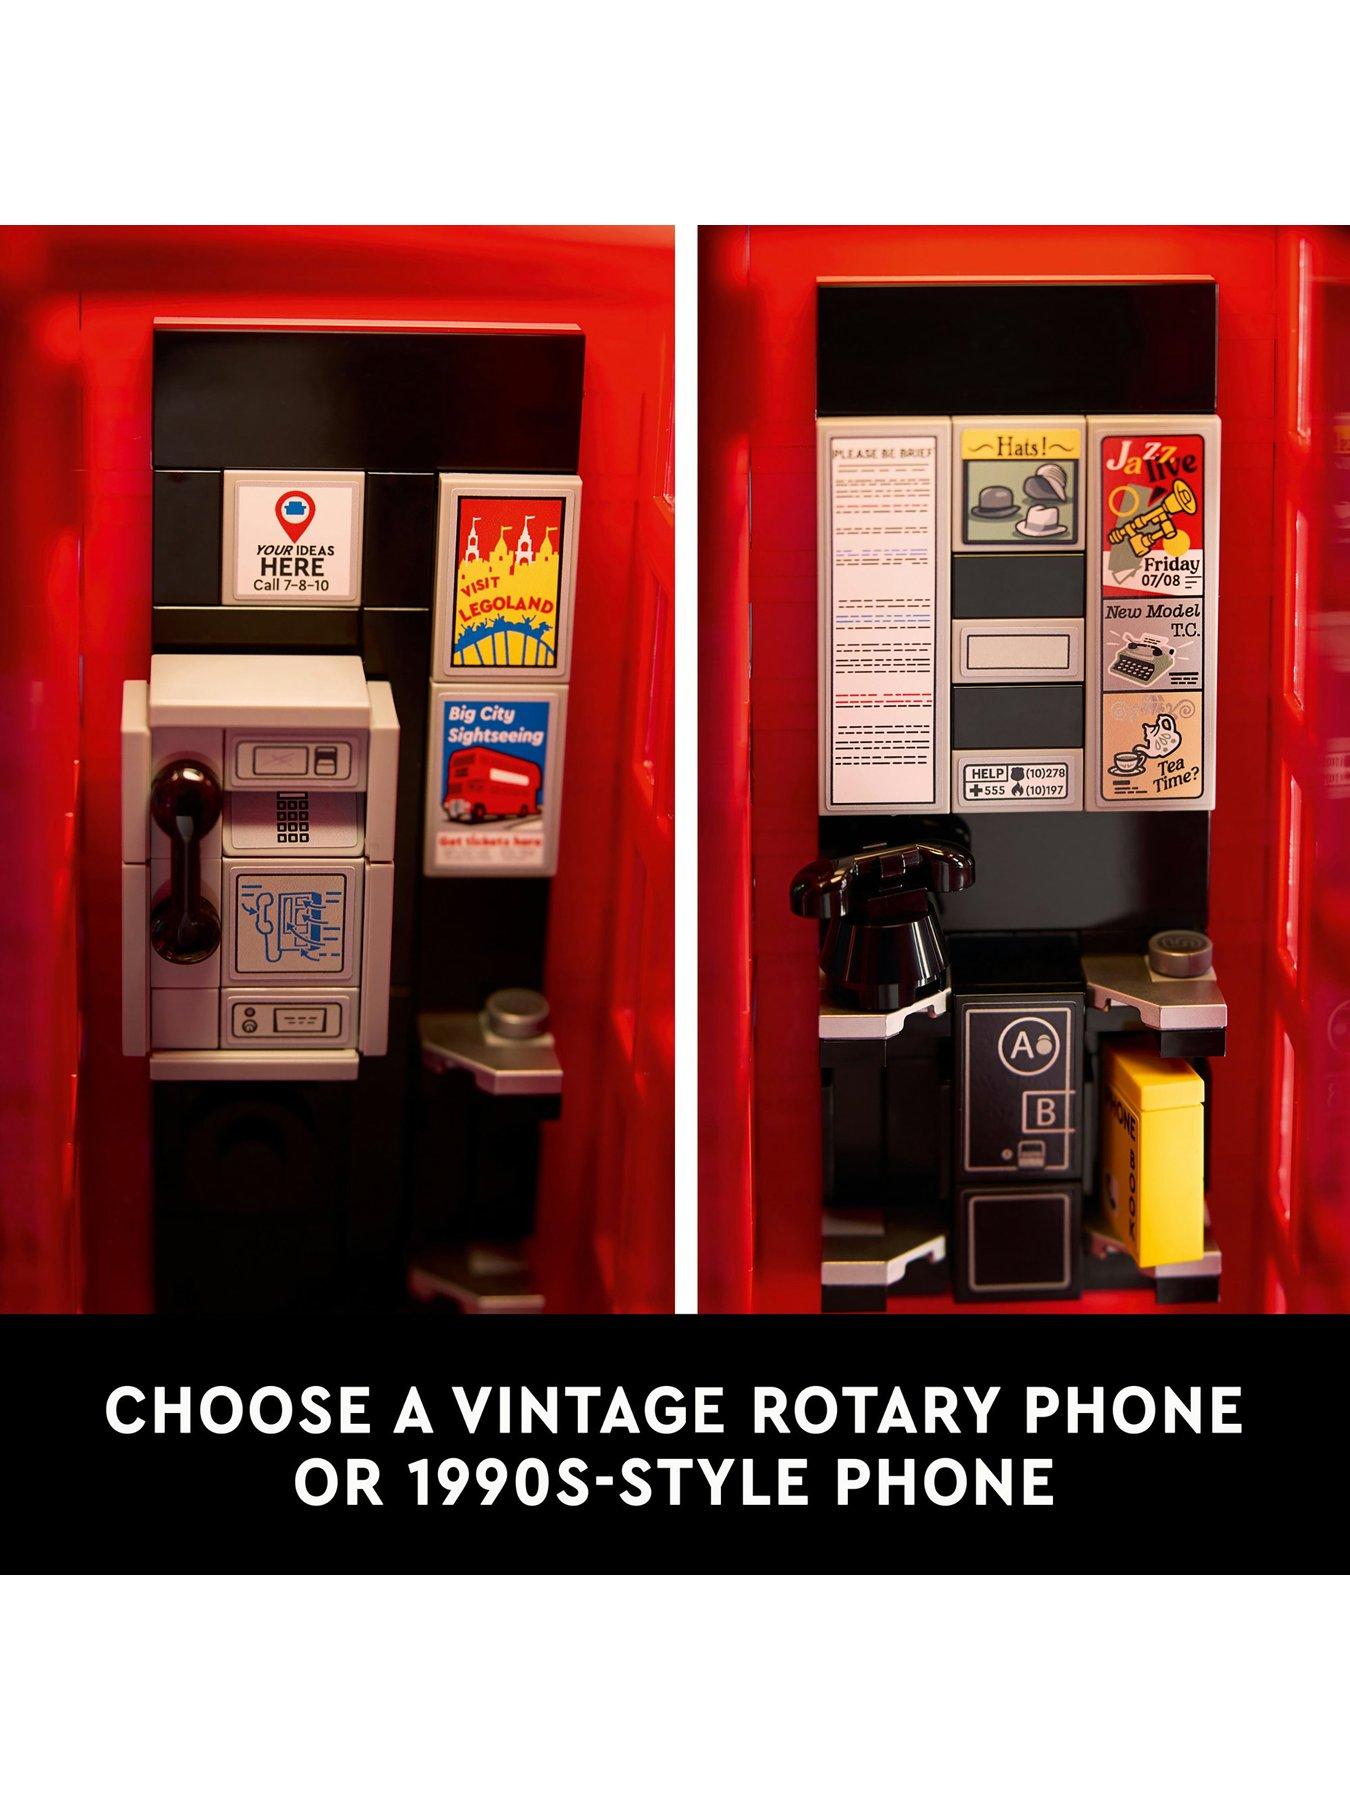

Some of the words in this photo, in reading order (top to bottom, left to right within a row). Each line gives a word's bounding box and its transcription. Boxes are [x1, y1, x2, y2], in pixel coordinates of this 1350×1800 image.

[998, 436, 1047, 456] Hats!
[1106, 440, 1178, 475] Jazz
[1146, 454, 1198, 483] live
[256, 545, 293, 556] YOUR
[296, 545, 335, 556] IDEAS
[261, 557, 324, 577] HERE
[1144, 556, 1200, 575] Friday
[253, 578, 280, 591] Call
[283, 579, 329, 592] 7-8-10
[460, 576, 500, 597] VISIT
[1141, 573, 1181, 588] 07/08
[458, 595, 554, 622] LEGOLAND
[1105, 605, 1142, 619] New
[1145, 604, 1201, 618] Model
[1171, 622, 1201, 637] T.C.
[448, 704, 477, 724] Big
[480, 704, 516, 725] City
[447, 726, 545, 747] Sightseeing
[972, 768, 1004, 779] HELP
[1025, 767, 1066, 780] (10)278
[1157, 758, 1185, 776] Tea
[1152, 766, 1200, 793] Time?
[984, 785, 1005, 796] 555
[1025, 785, 1064, 797] (10)197
[1010, 1030, 1034, 1058] A
[1036, 1097, 1056, 1126] B
[1128, 1148, 1136, 1241] BOOK
